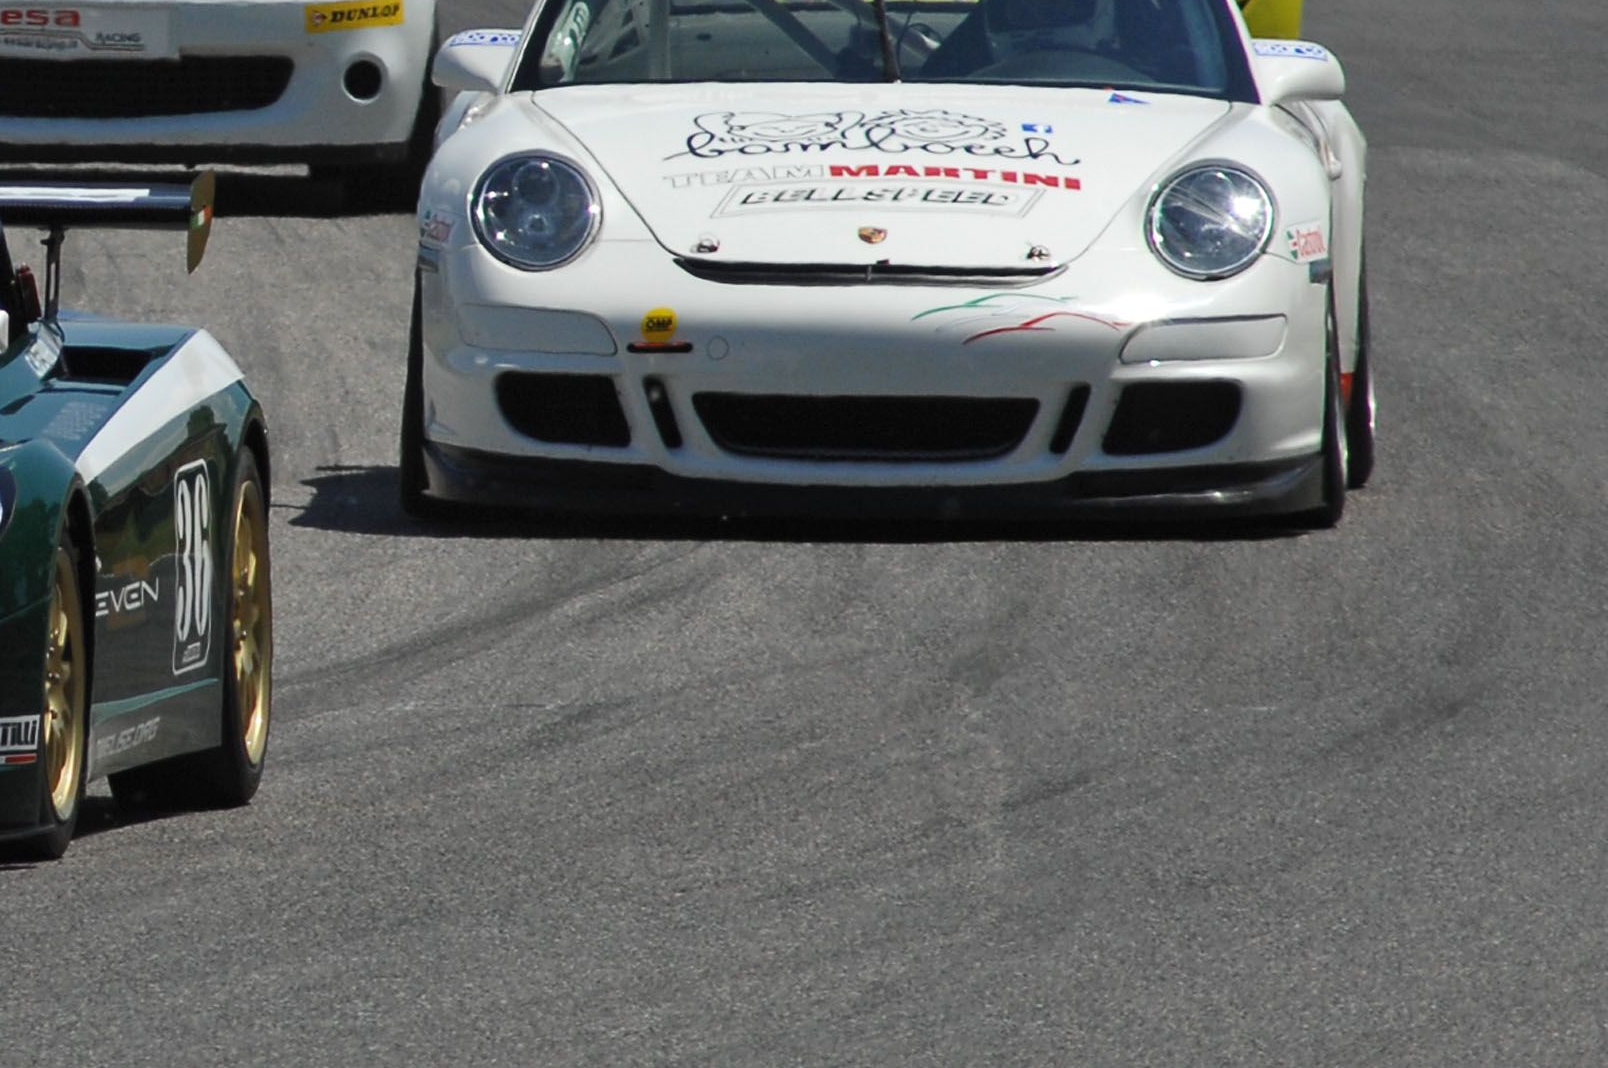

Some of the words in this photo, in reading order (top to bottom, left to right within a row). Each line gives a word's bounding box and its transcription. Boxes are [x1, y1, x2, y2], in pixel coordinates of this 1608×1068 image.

[330, 2, 401, 23] DUNLOP
[663, 164, 826, 189] TEAM
[828, 164, 1082, 191] MARTINI
[94, 576, 159, 617] EVEN
